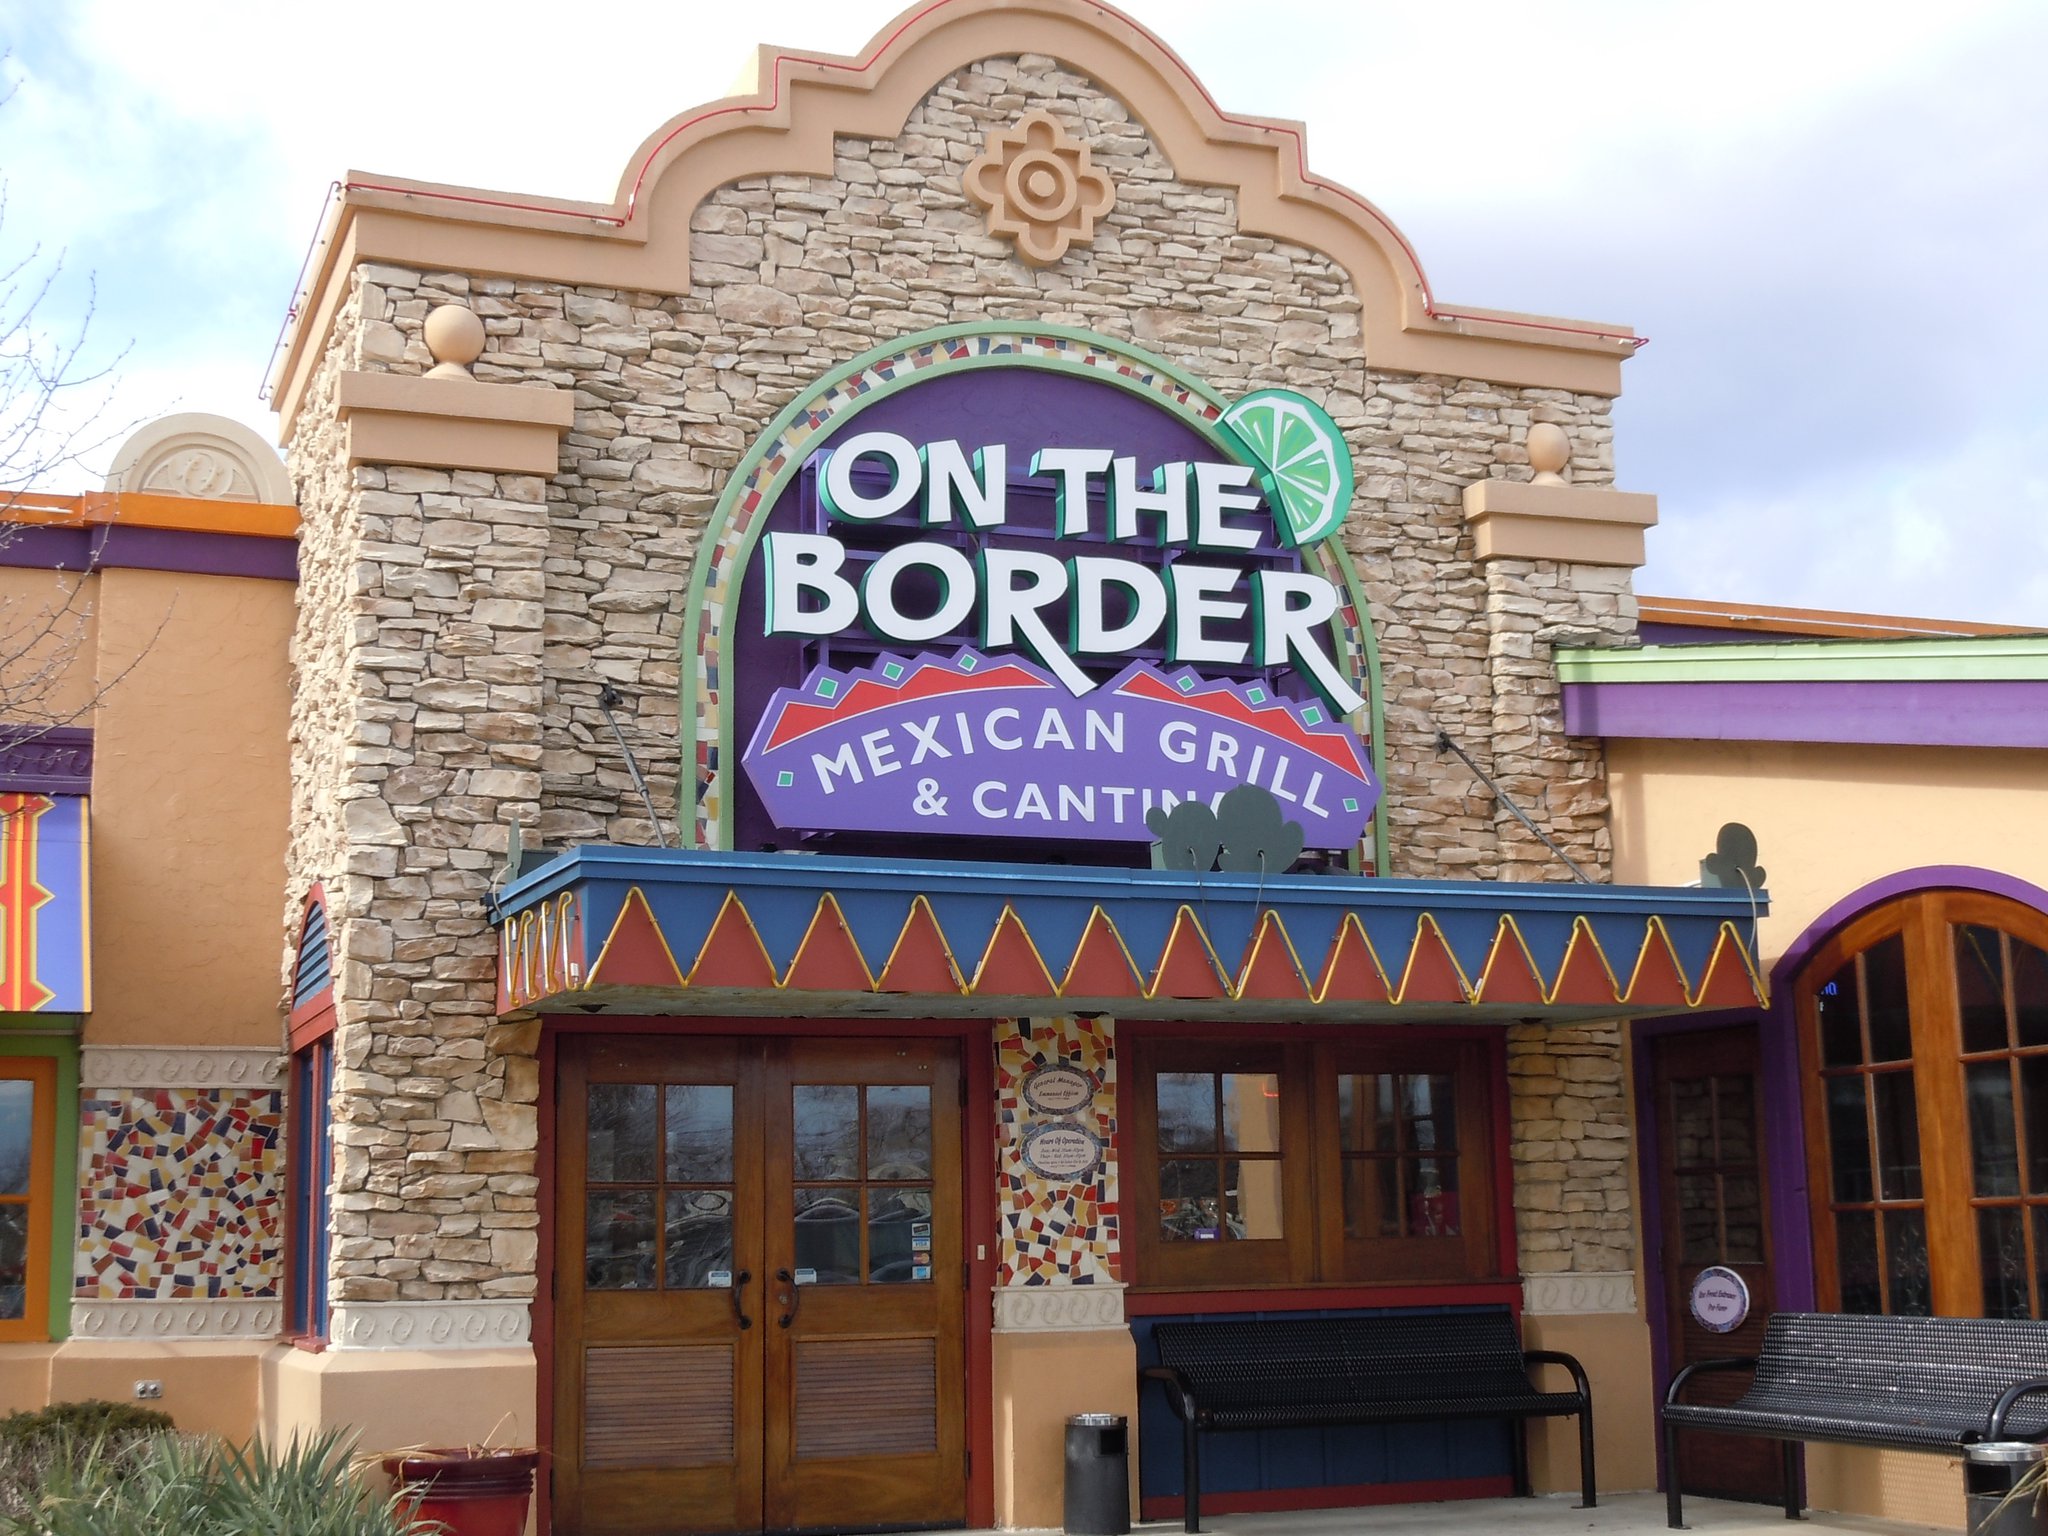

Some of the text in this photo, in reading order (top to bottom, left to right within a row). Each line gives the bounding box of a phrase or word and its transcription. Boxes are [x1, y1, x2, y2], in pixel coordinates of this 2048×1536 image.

[819, 431, 1263, 550] ON THE
[762, 531, 1367, 715] BORDER
[811, 707, 1330, 819] MEXICAN GRILL
[912, 777, 948, 818] &
